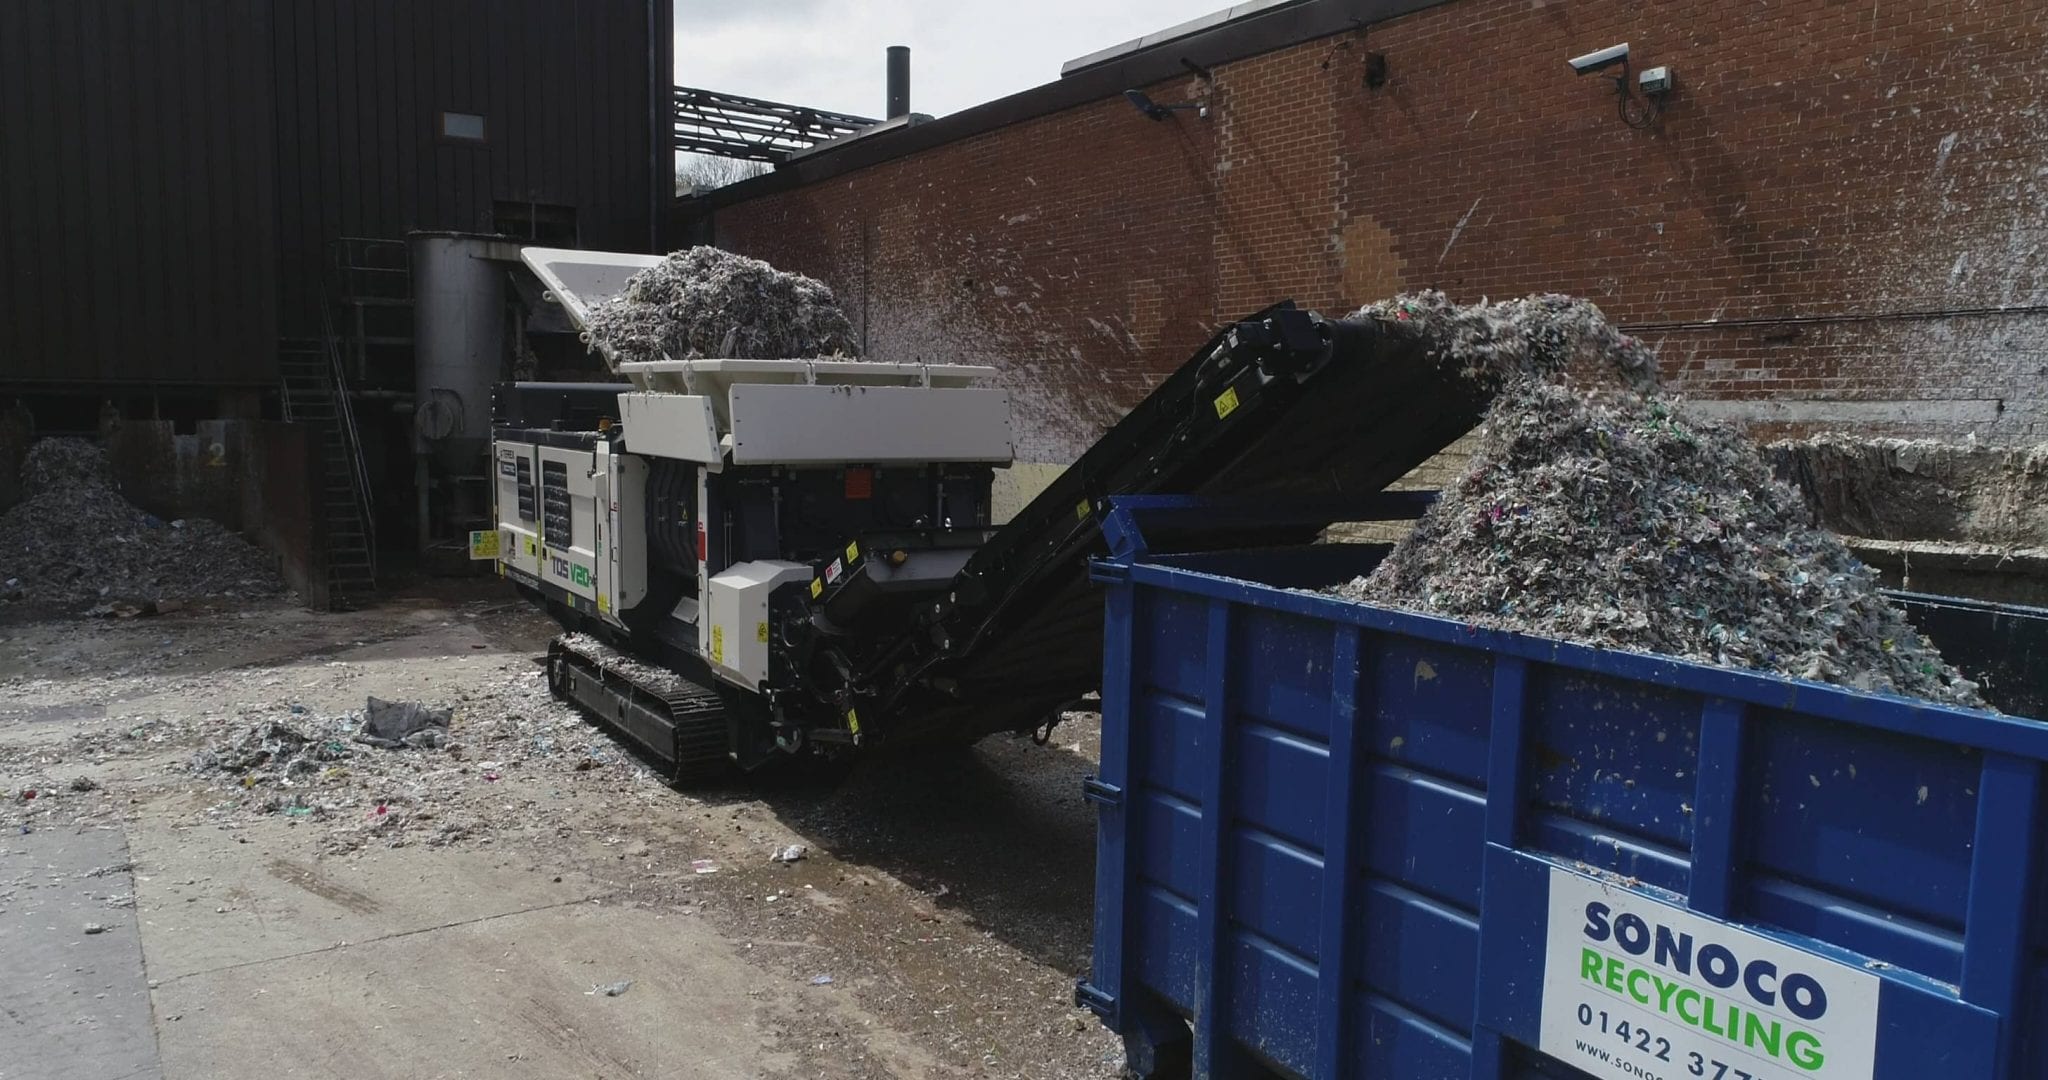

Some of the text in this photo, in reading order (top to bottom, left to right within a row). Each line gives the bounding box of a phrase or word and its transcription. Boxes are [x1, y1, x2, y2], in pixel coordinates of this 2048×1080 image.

[208, 442, 228, 467] 2
[1580, 948, 1825, 1071] RECYCLING
[1583, 901, 1828, 1021] SONOCO
[1577, 1003, 1764, 1080] 01422 377
